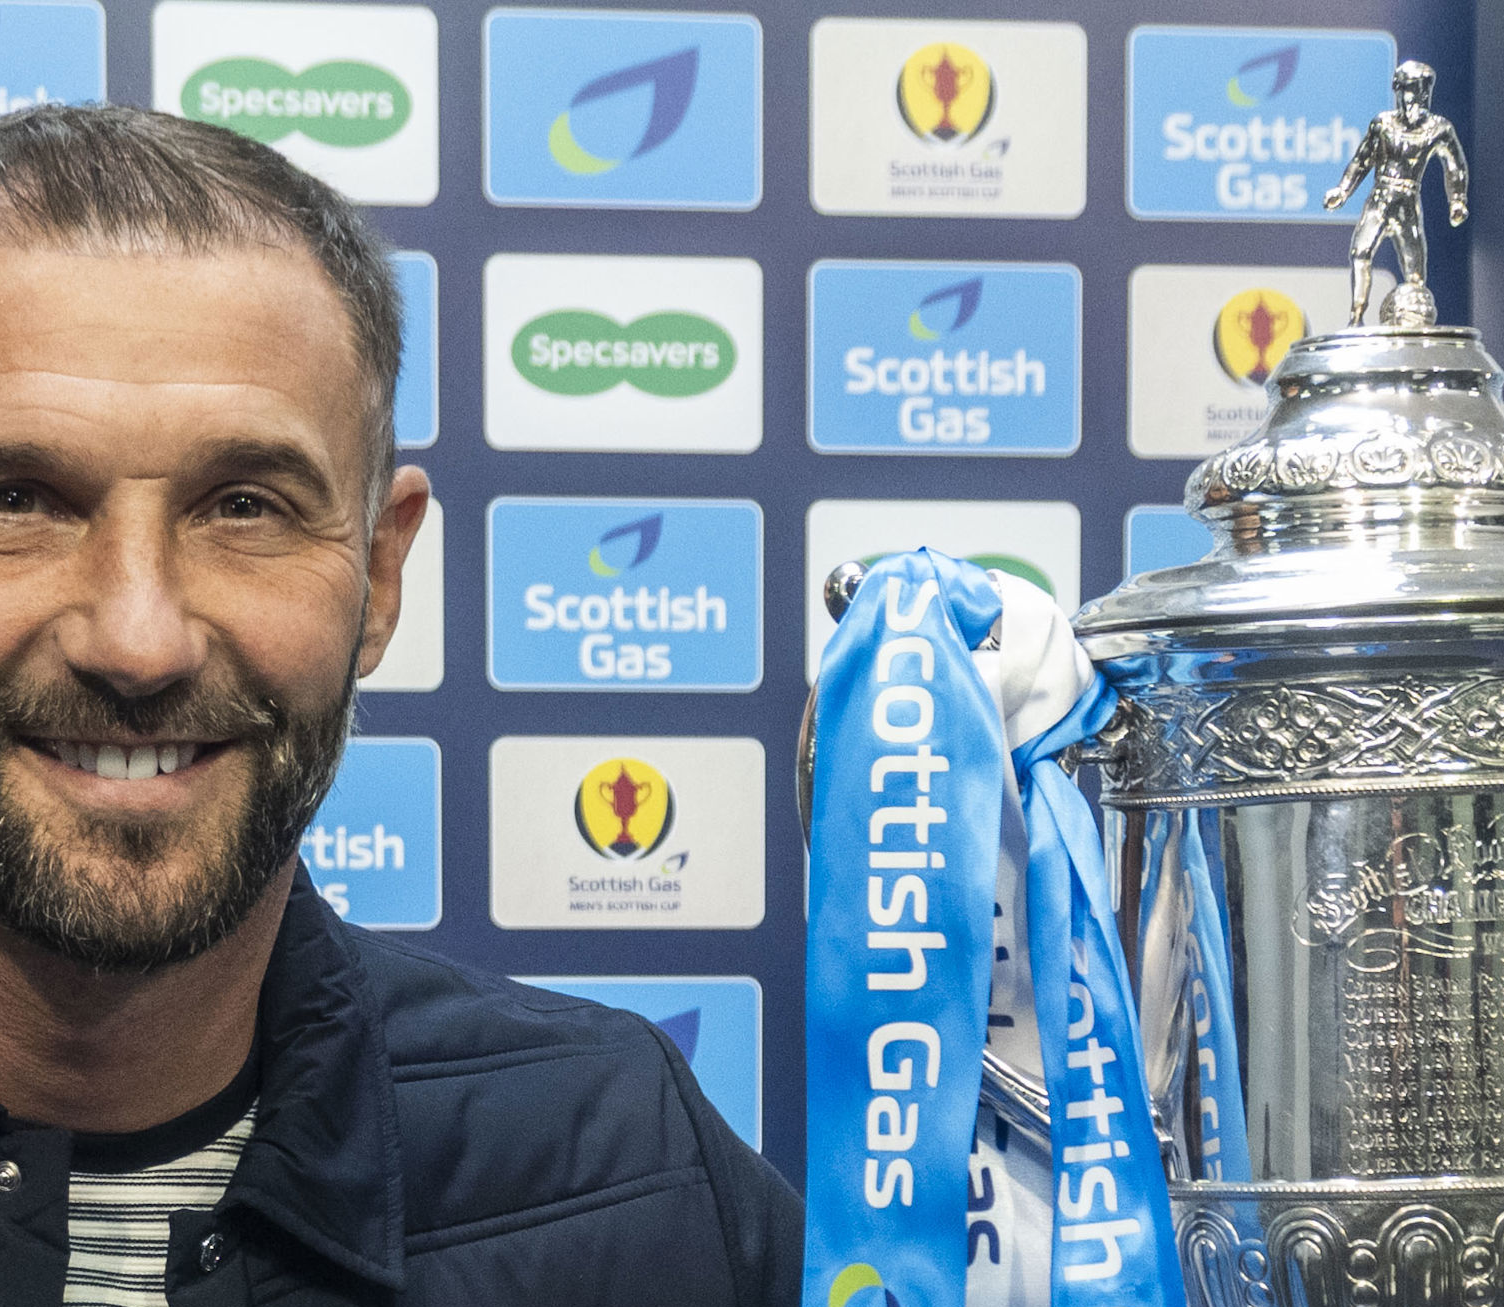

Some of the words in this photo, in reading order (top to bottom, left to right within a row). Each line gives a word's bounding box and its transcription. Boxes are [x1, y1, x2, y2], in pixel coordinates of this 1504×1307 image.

[199, 81, 394, 120] Specsavers
[1163, 112, 1361, 164] Scottish
[1217, 167, 1307, 210] Gas
[530, 333, 720, 371] Specsavers
[844, 347, 1045, 397] Scottish
[899, 397, 990, 443] Gas
[524, 584, 726, 633] Scottish
[580, 633, 671, 679] Gas
[866, 576, 950, 991] Scottish
[568, 877, 643, 893] Scottish
[647, 877, 681, 893] Gas
[863, 1021, 941, 1209] Gas
